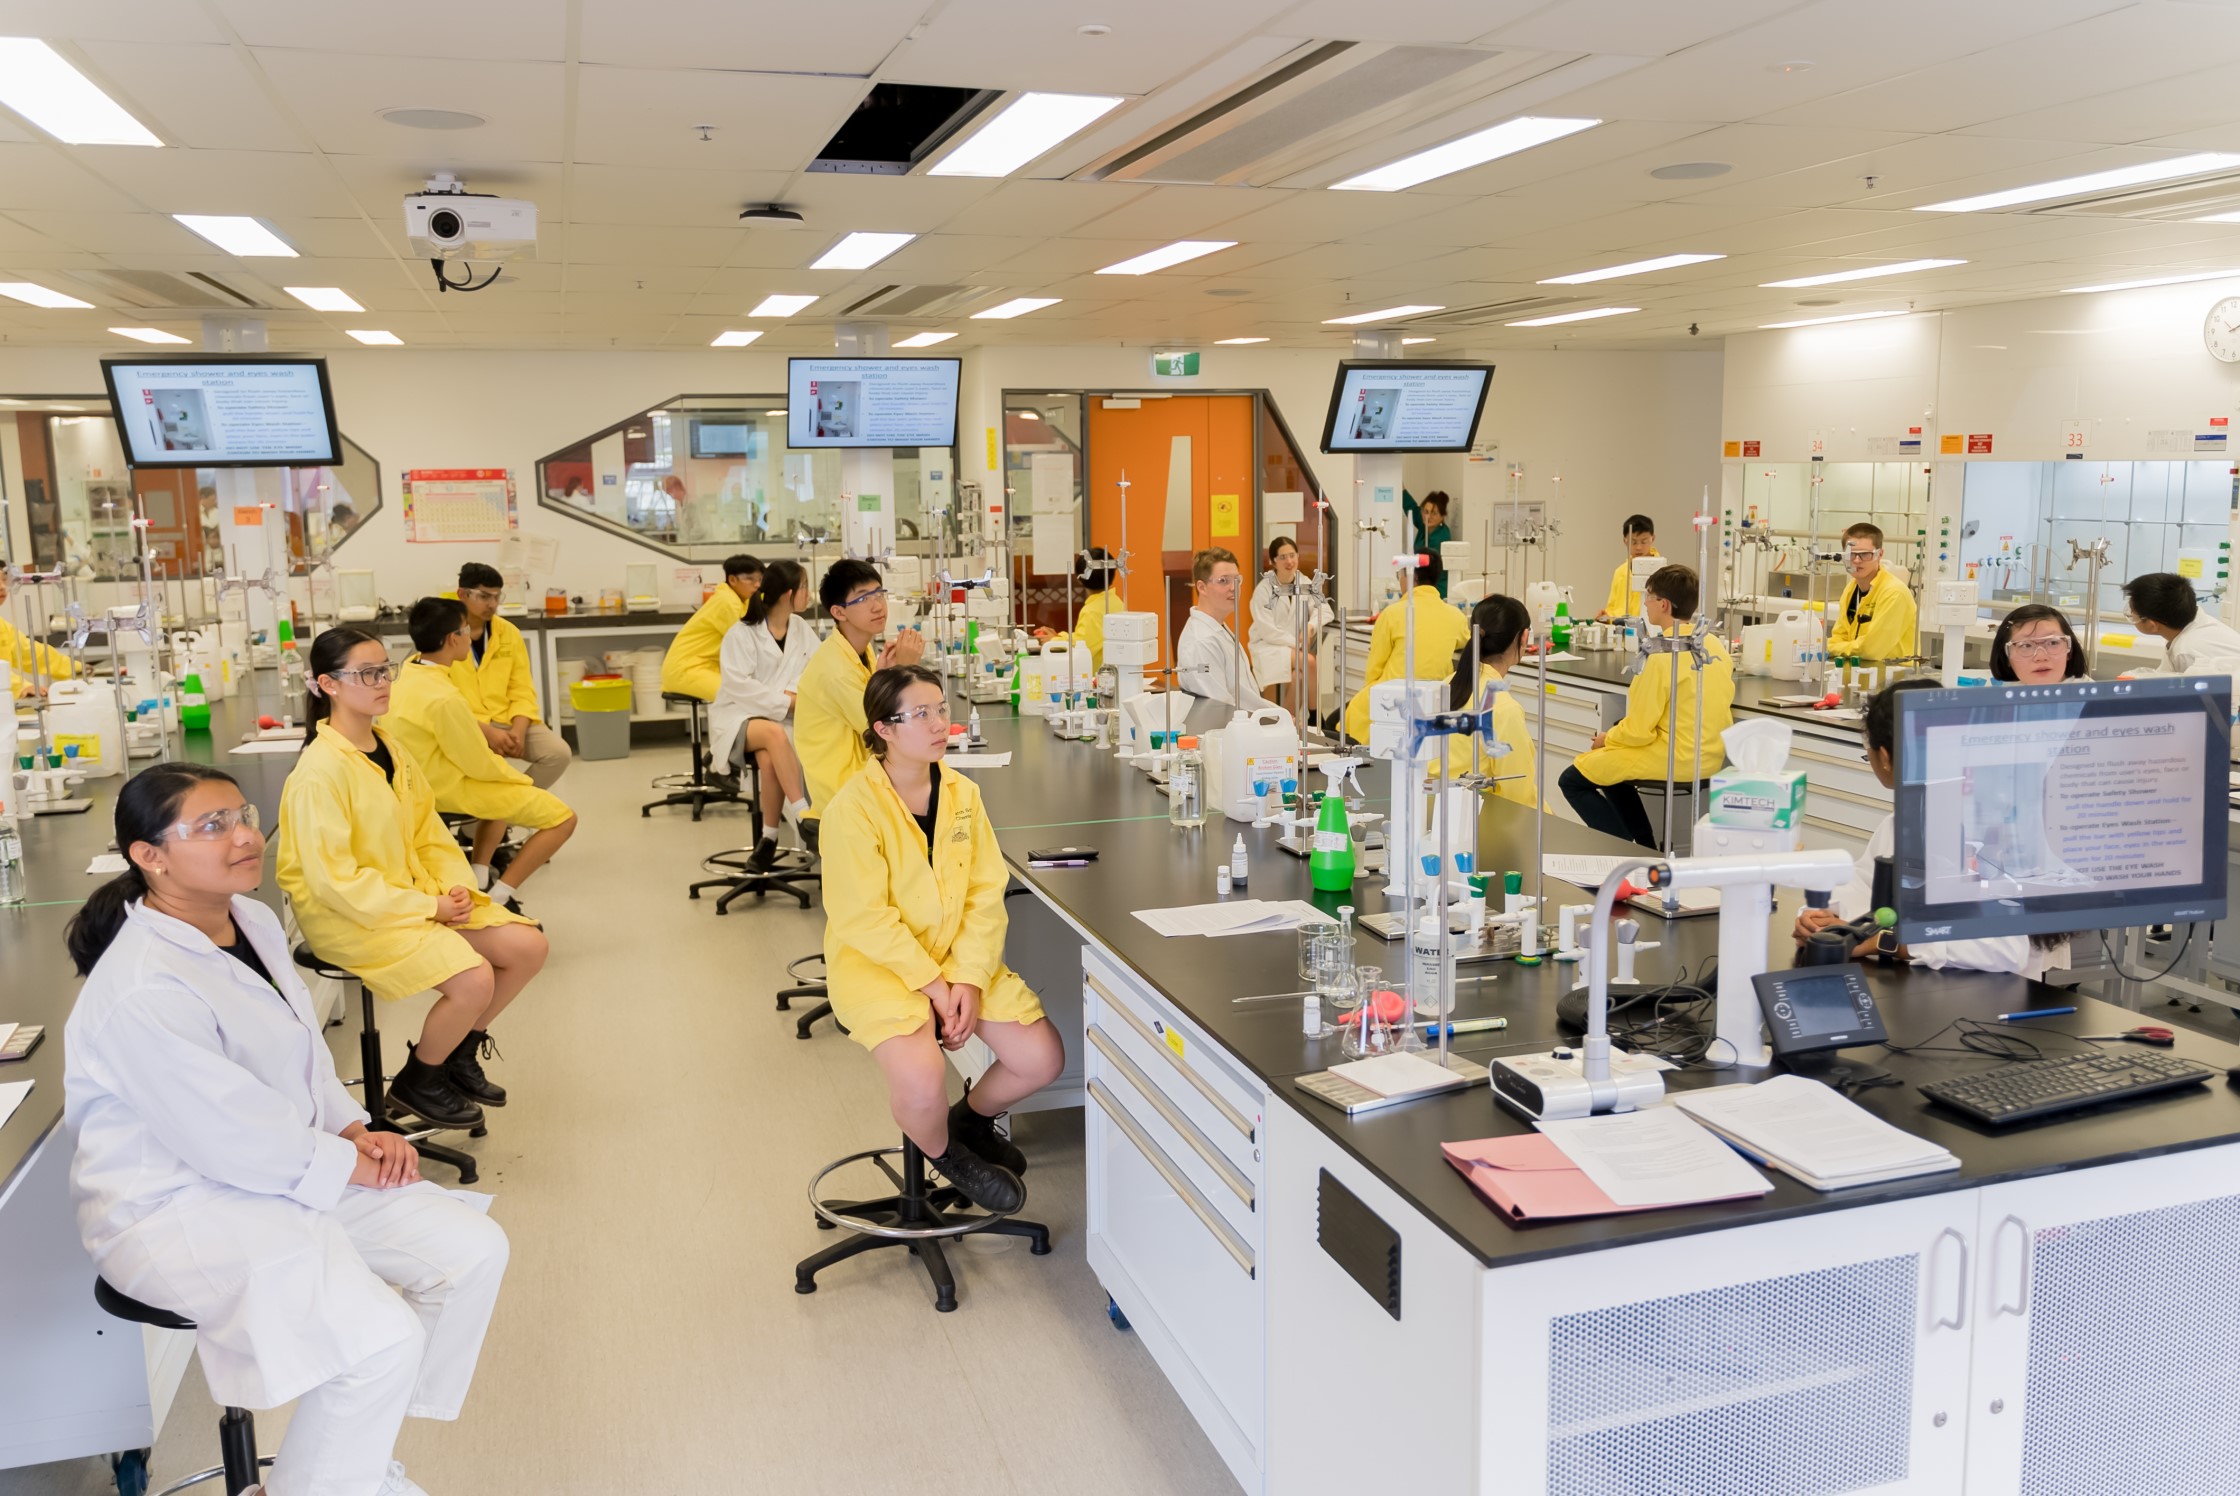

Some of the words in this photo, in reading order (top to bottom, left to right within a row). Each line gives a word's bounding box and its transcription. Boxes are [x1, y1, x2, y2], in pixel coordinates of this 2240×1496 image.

[1812, 440, 1823, 452] 34
[2067, 433, 2082, 447] 33
[1960, 734, 2031, 746] Emergency
[2035, 728, 2081, 741] shower
[2084, 726, 2108, 737] and
[2112, 726, 2139, 738] eyes
[2143, 722, 2175, 734] wash
[2048, 744, 2090, 756] station
[1723, 796, 1774, 807] KIMTECH
[1415, 946, 1449, 956] WATE
